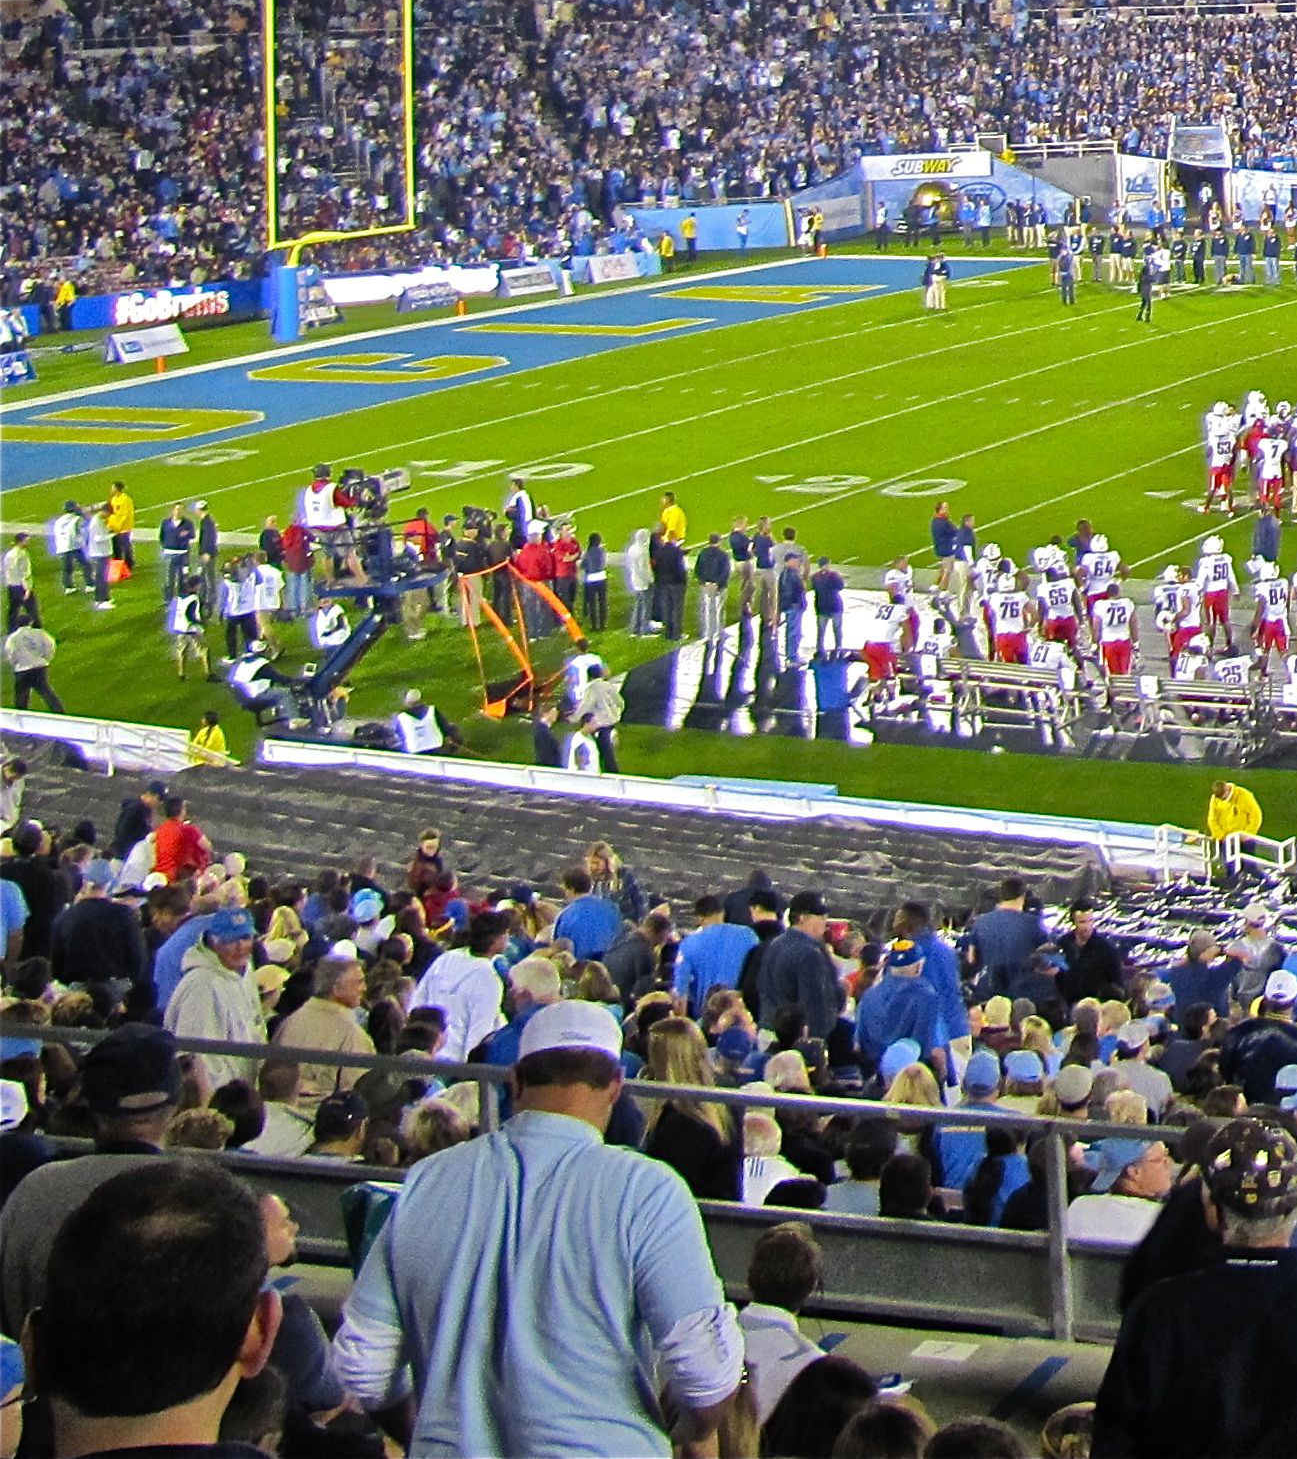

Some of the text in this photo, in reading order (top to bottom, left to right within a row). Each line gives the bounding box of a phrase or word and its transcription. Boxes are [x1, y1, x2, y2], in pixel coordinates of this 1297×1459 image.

[892, 156, 961, 176] SUBWAY
[114, 287, 231, 325] #GoBruins
[1216, 441, 1231, 455] 53
[1271, 444, 1280, 458] 7
[771, 473, 969, 497] 20
[1093, 560, 1113, 577] 64
[1213, 563, 1229, 580] 50
[1269, 587, 1287, 606] 84
[1000, 601, 1020, 619] 76
[1106, 605, 1127, 625] 72
